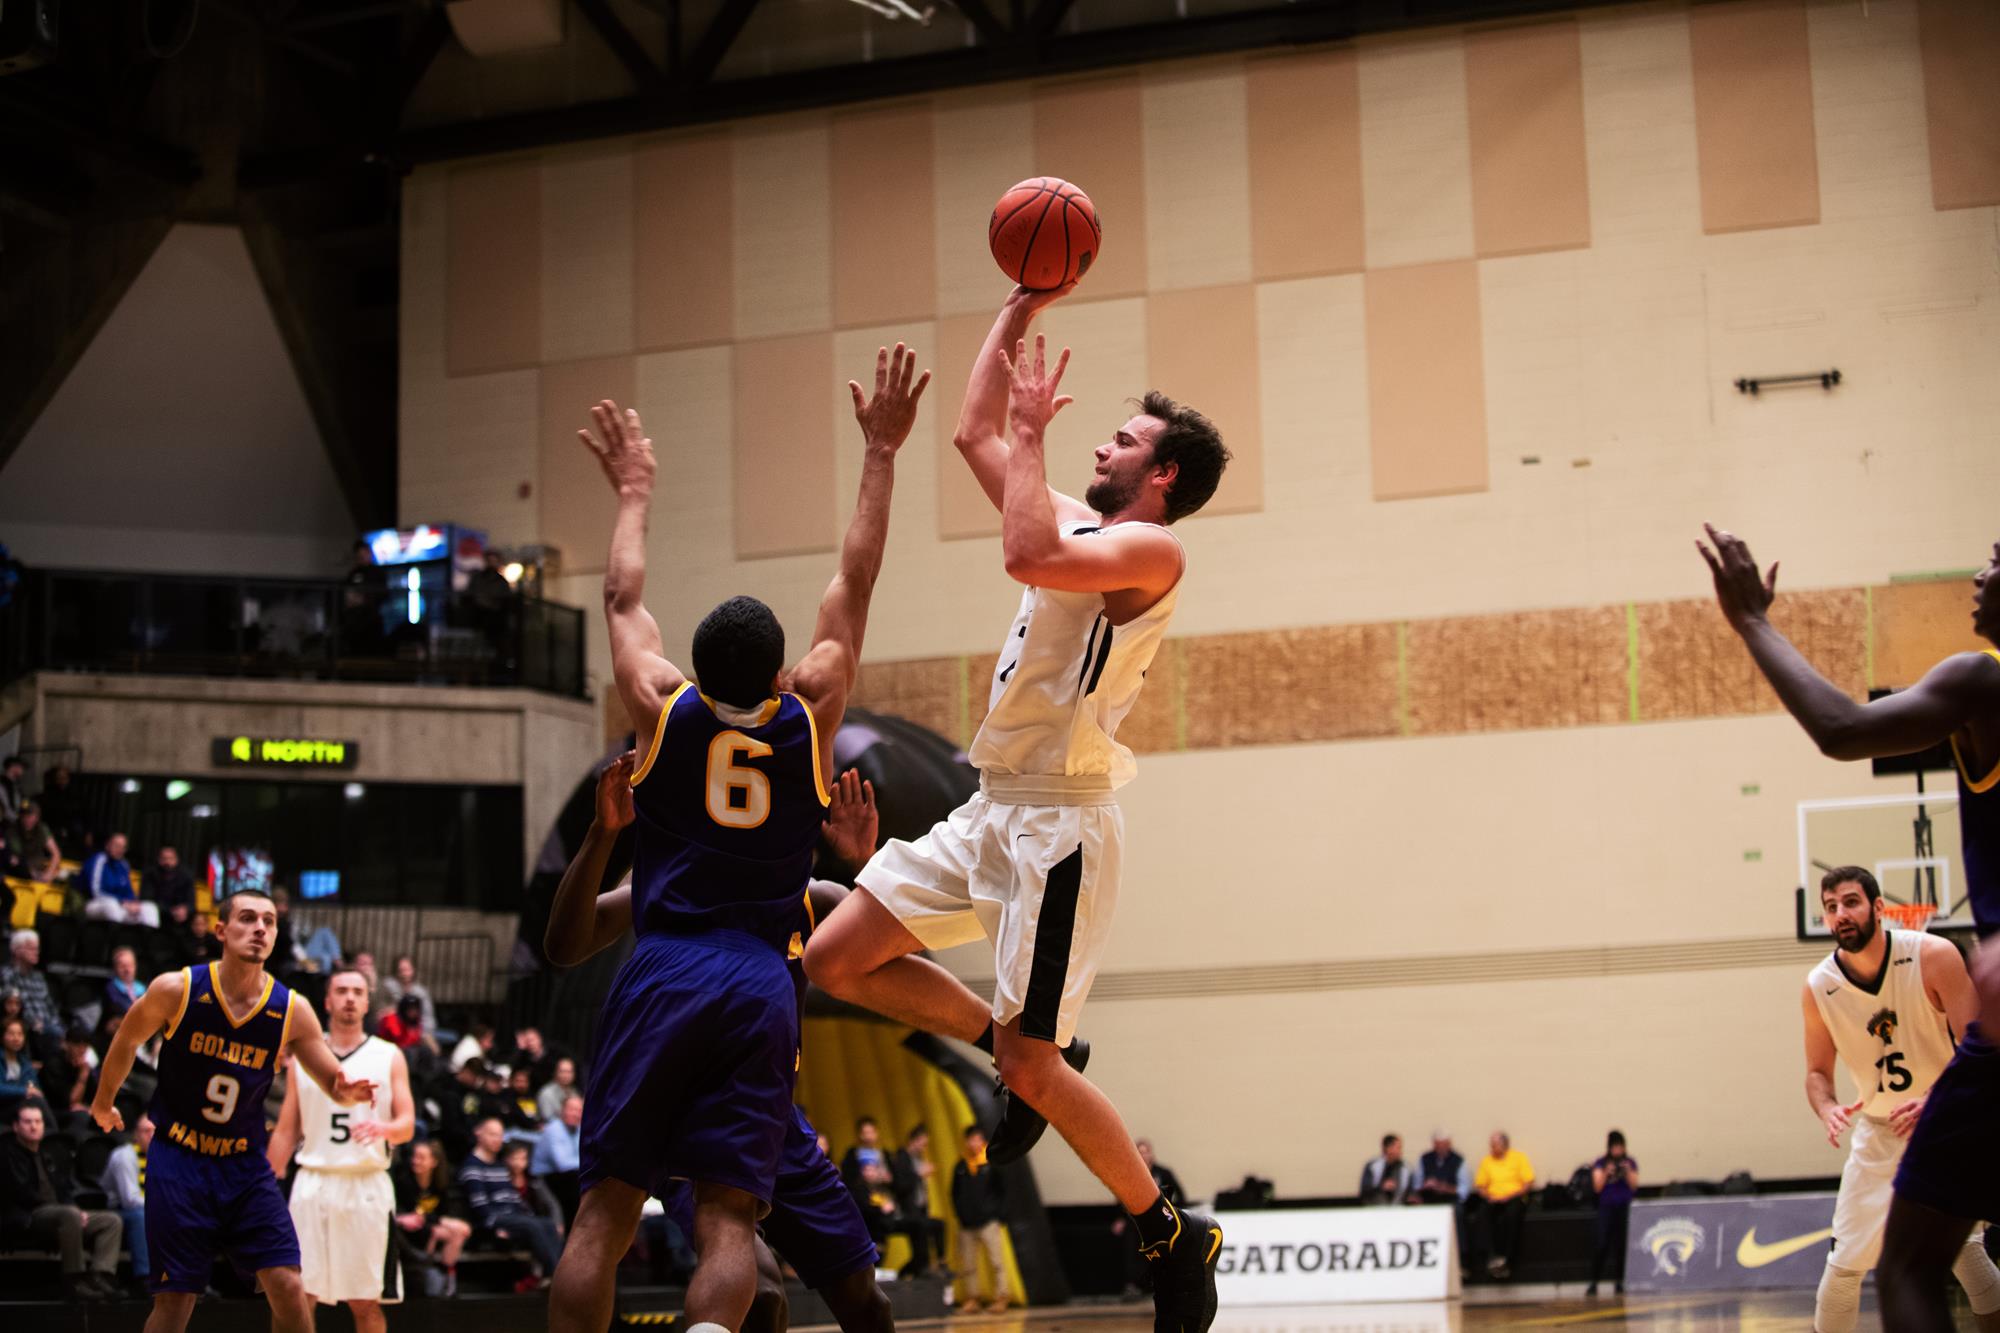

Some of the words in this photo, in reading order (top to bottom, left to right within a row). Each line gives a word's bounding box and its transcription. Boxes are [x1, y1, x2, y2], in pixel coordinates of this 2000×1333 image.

[262, 739, 345, 763] NORTH
[705, 729, 774, 829] 6
[190, 1032, 268, 1070] GOLDEN
[1875, 1052, 1913, 1092] 15
[201, 1074, 240, 1124] 9
[168, 1121, 248, 1157] HAWKS
[330, 1113, 351, 1144] 5
[1215, 1238, 1438, 1275] GATORADE
